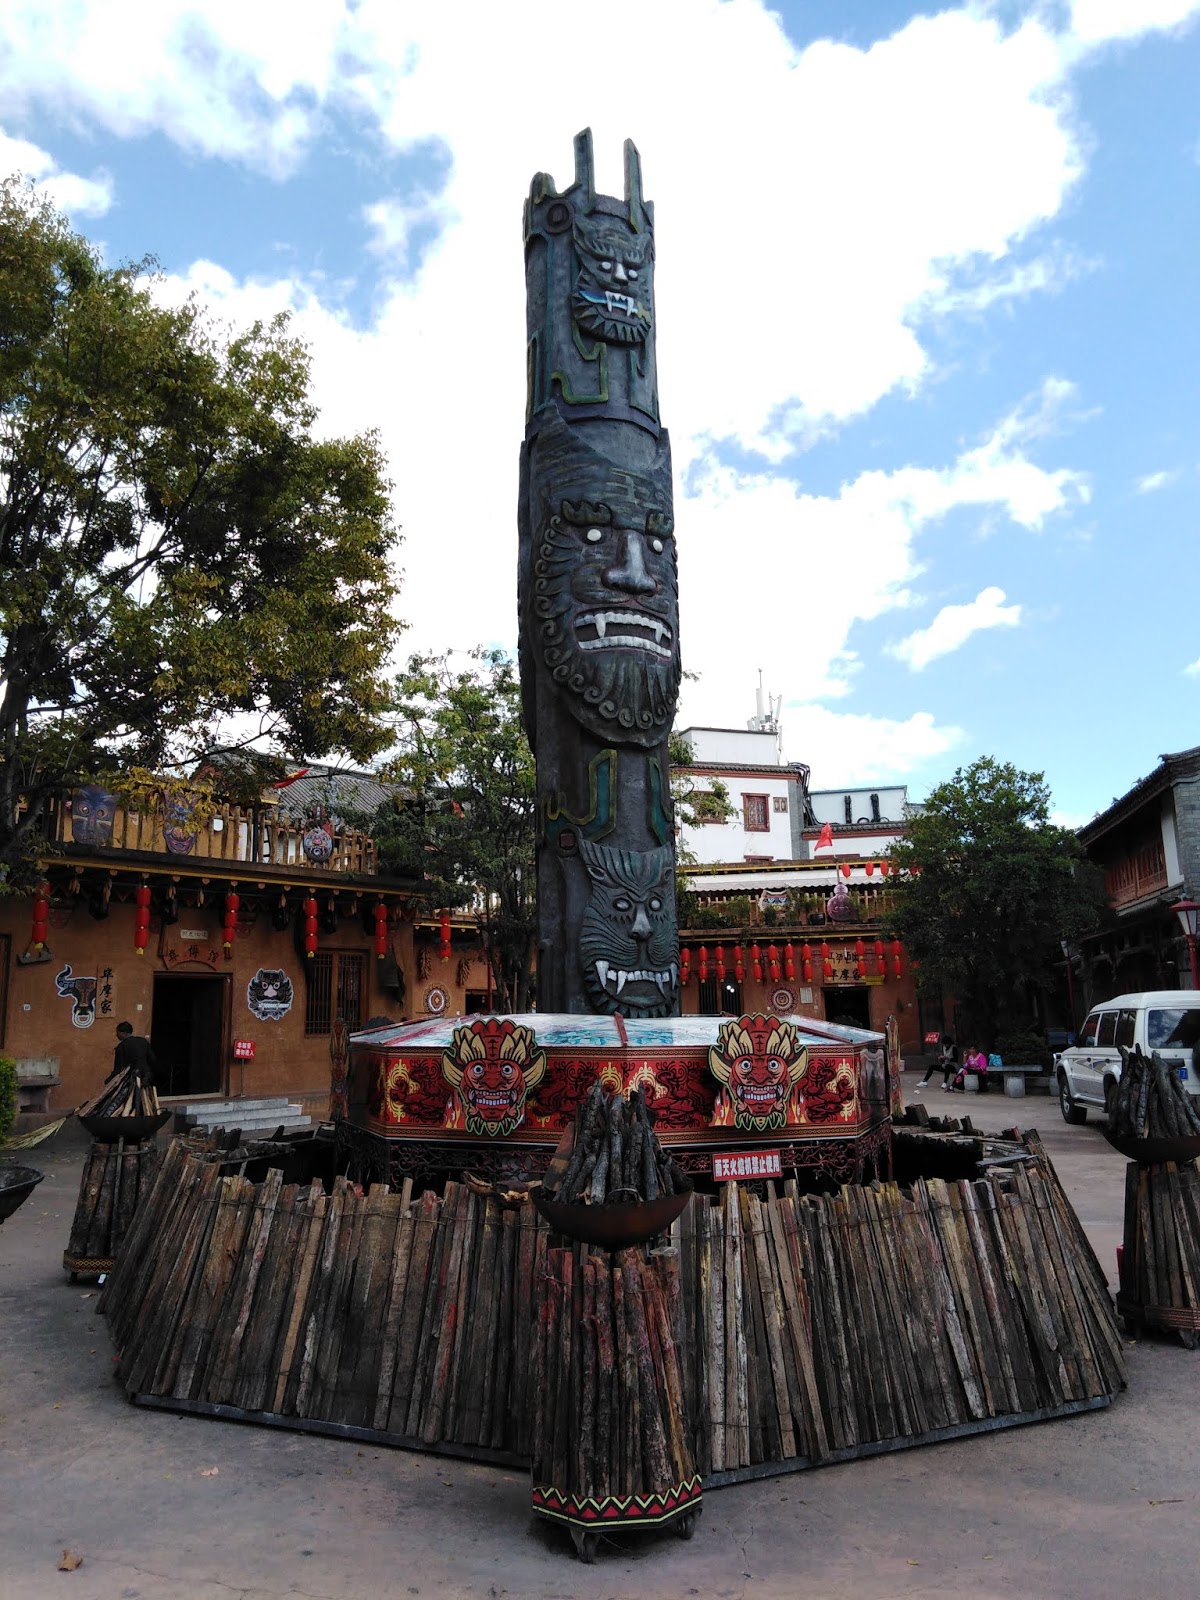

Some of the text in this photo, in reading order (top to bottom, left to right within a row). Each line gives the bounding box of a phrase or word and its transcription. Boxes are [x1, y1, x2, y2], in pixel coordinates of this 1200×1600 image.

[714, 1154, 780, 1177] 雨天火焰机禁止使用
